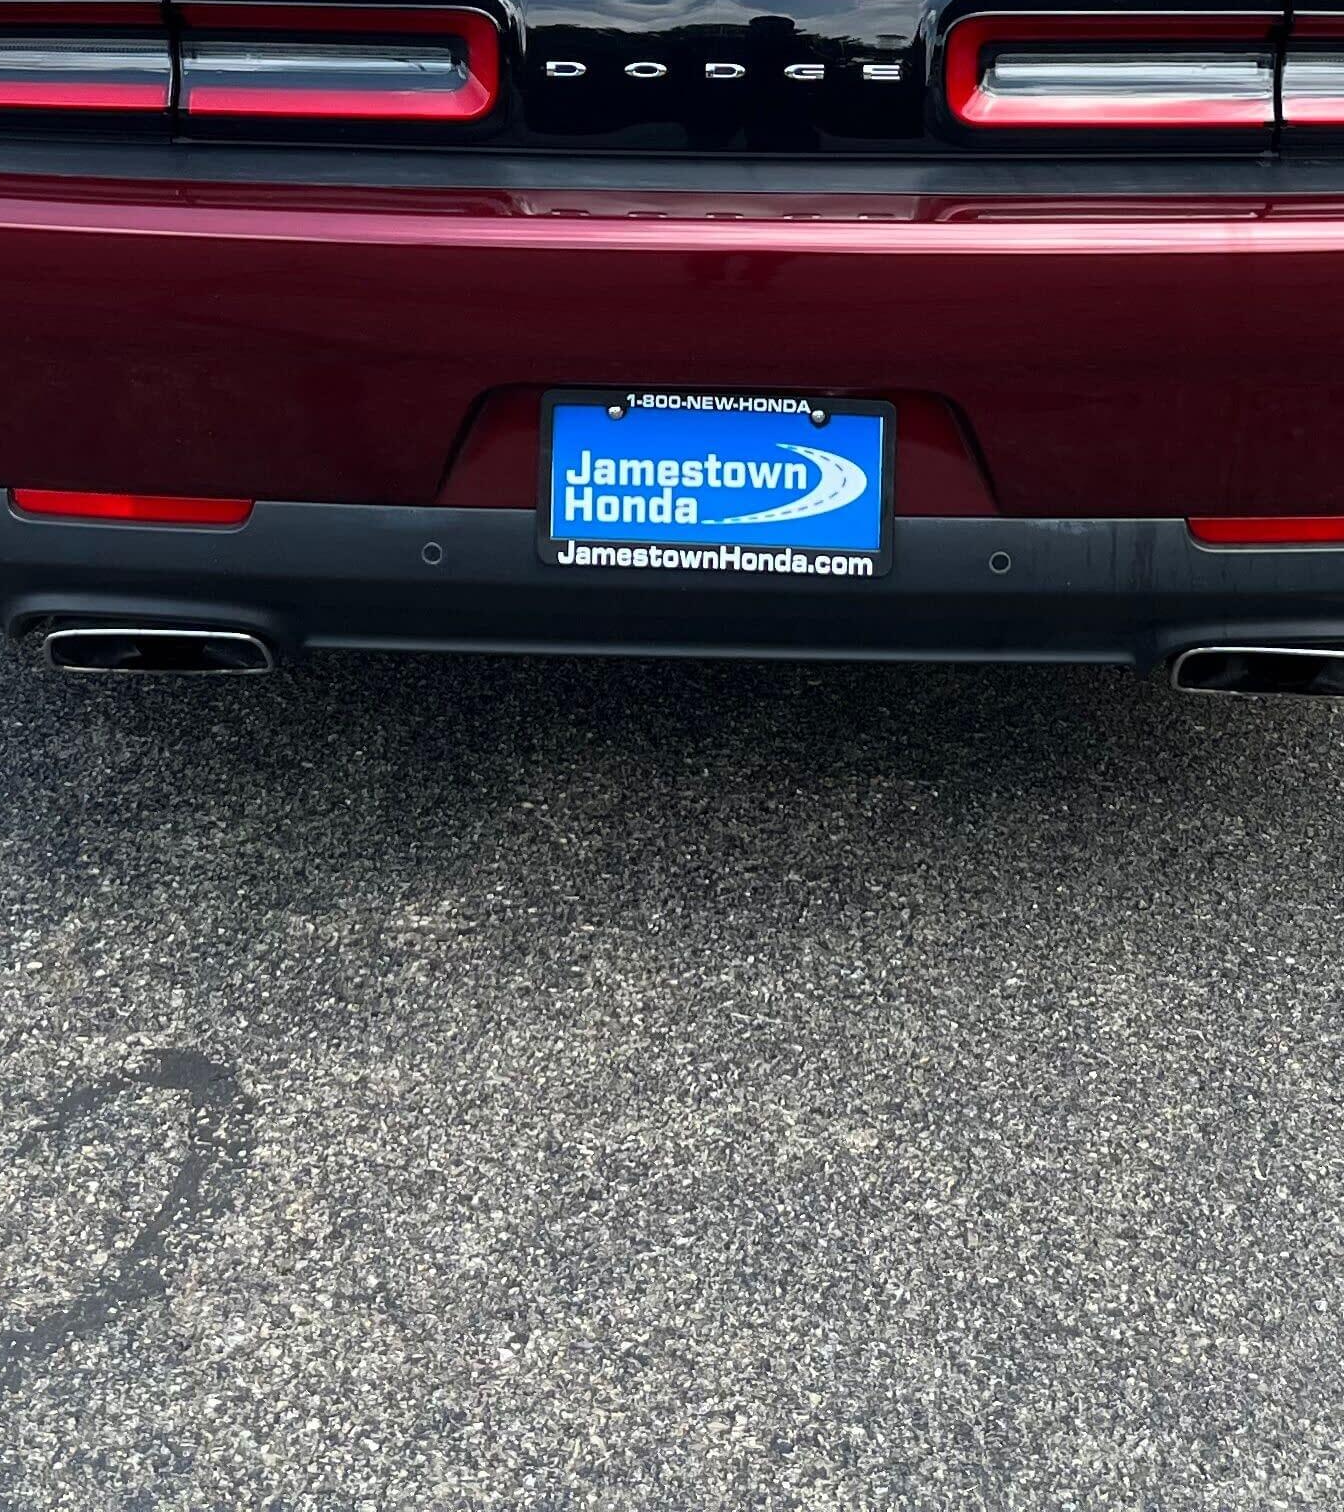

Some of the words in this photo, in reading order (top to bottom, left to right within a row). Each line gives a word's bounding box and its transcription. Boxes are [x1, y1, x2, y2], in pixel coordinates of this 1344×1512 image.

[545, 60, 902, 81] DODGE
[626, 393, 811, 414] 1-800-NEW-HONDA
[565, 449, 807, 490] Jamestown
[564, 486, 698, 525] Honda
[556, 539, 873, 576] JamestownHonda.com
